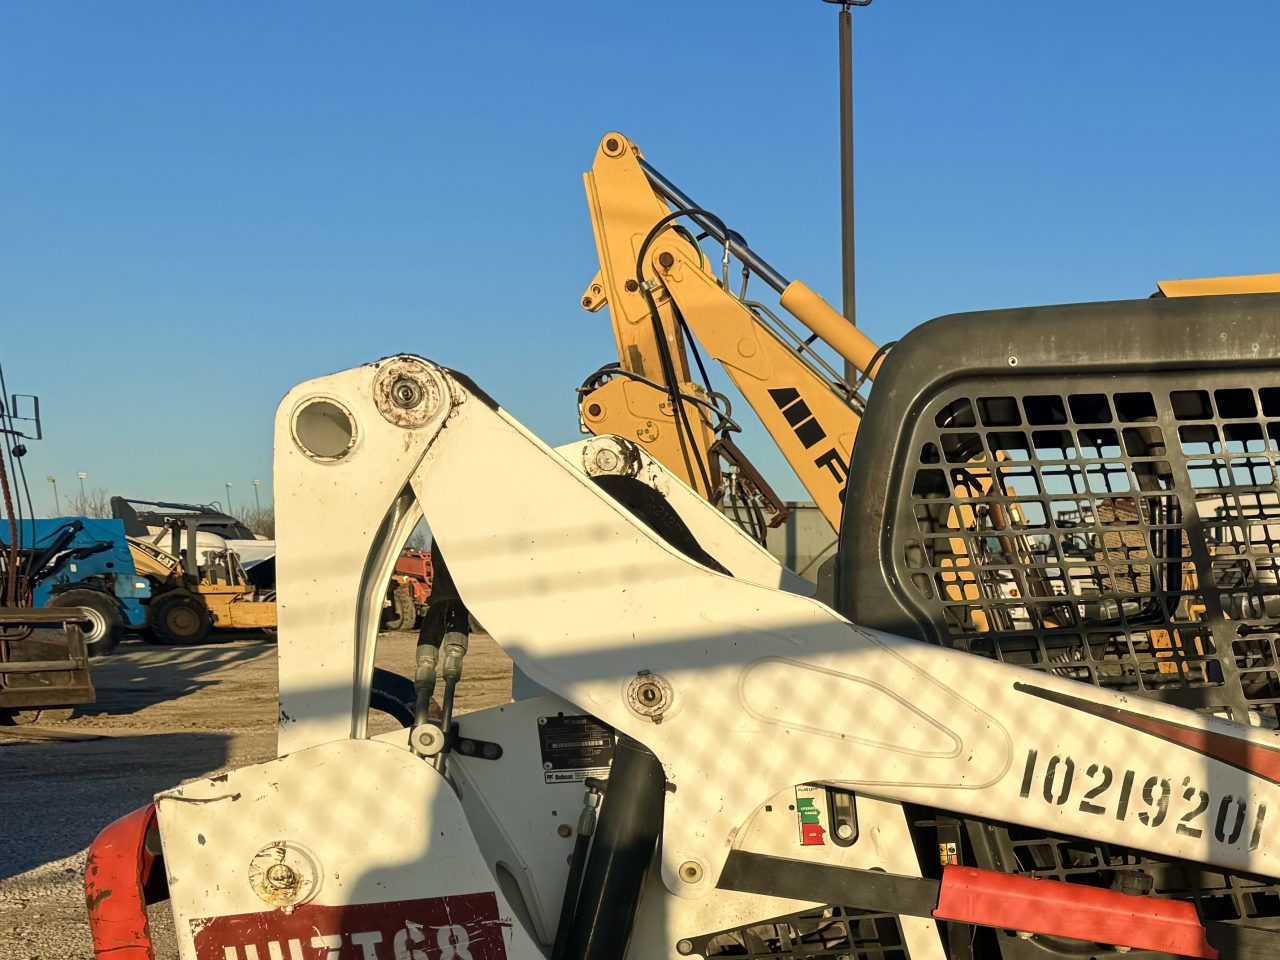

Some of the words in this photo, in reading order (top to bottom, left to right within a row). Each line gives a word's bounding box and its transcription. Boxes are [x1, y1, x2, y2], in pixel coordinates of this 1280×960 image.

[813, 447, 851, 506] F
[156, 553, 175, 568] CAT
[1019, 748, 1267, 852] 10219201
